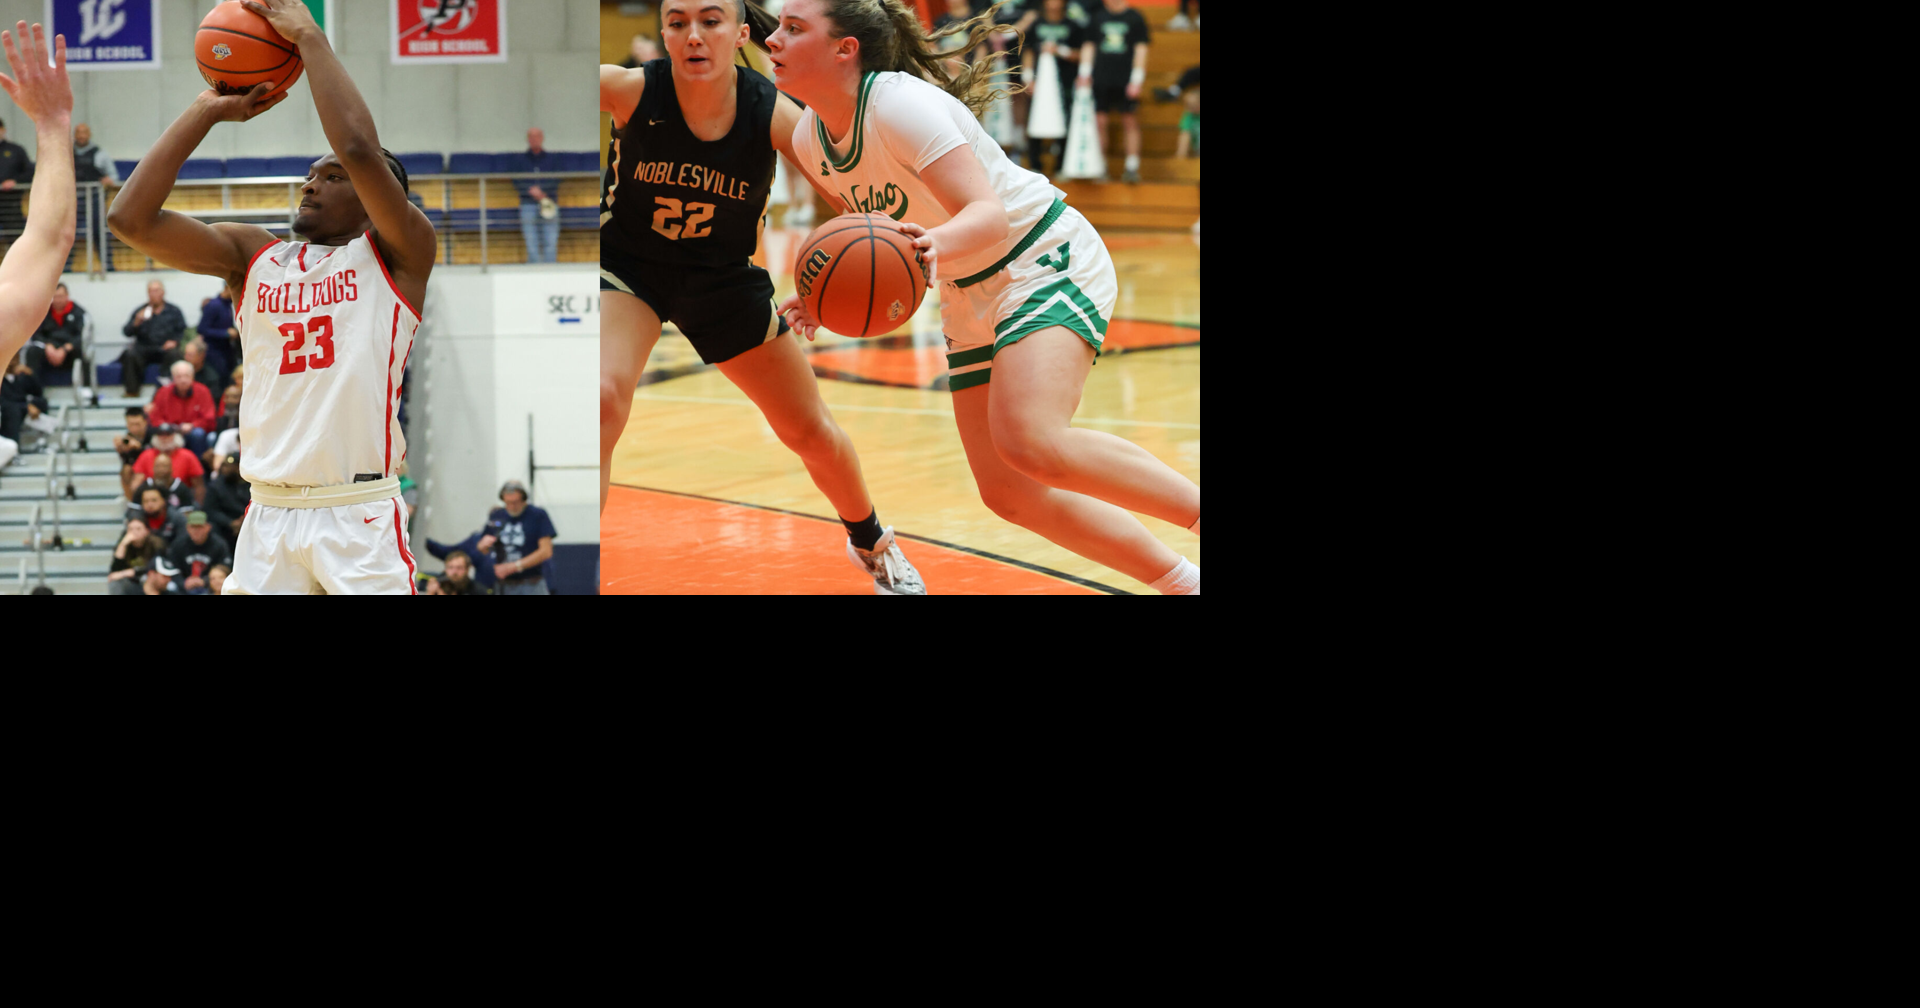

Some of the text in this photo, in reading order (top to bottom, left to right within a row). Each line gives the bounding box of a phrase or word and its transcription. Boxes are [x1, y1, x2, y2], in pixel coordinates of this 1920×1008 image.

[95, 45, 147, 60] SCHOOL
[408, 38, 490, 54] HIGH SCHOOL
[634, 161, 749, 200] NOBLESVILLE
[651, 196, 717, 240] 22
[1035, 241, 1070, 272] V
[257, 269, 358, 313] BULLDOGS
[278, 315, 335, 375] 23
